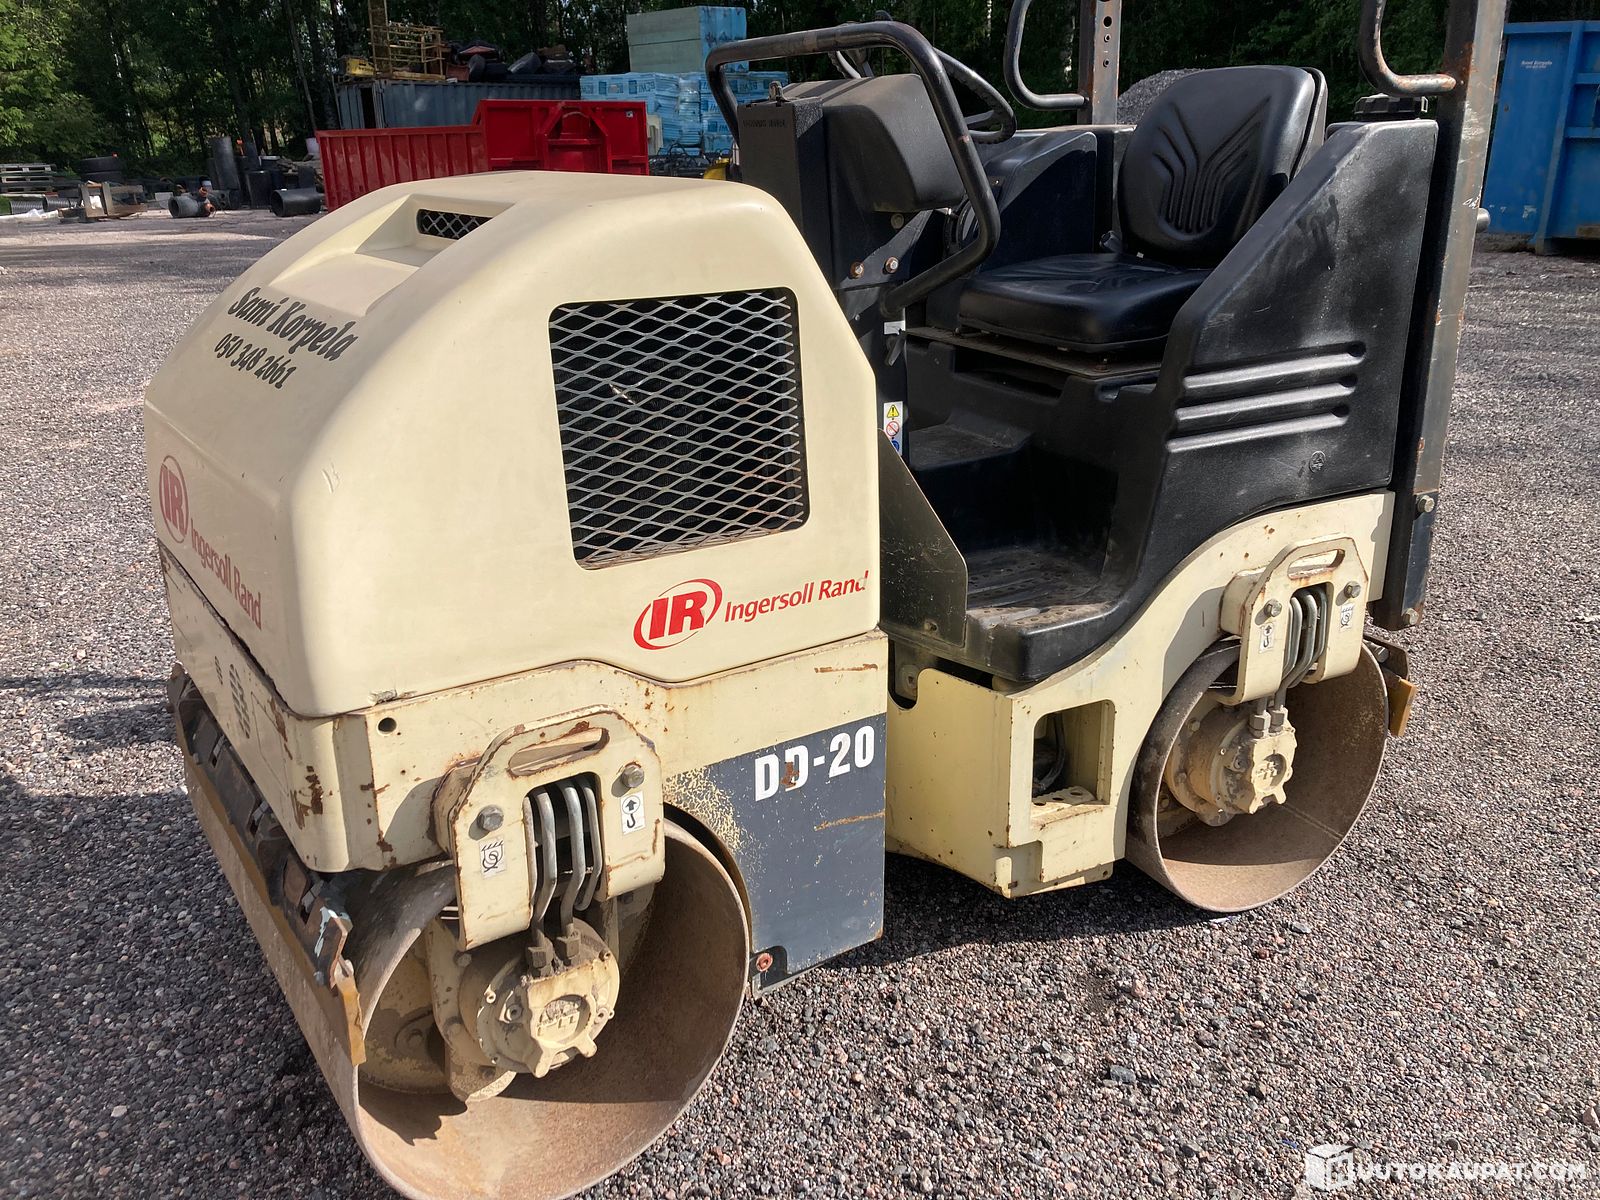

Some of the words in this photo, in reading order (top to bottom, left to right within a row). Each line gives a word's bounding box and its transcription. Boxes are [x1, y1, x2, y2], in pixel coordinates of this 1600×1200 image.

[214, 333, 244, 359] 050
[230, 343, 268, 372] 348
[254, 355, 297, 389] 2661
[228, 287, 281, 326] Sami
[266, 301, 358, 361] Korpela
[190, 517, 232, 593] Ingersoll
[233, 565, 262, 630] Rand
[648, 590, 708, 641] IR
[724, 582, 815, 623] Ingersoll
[754, 725, 875, 802] DD-20
